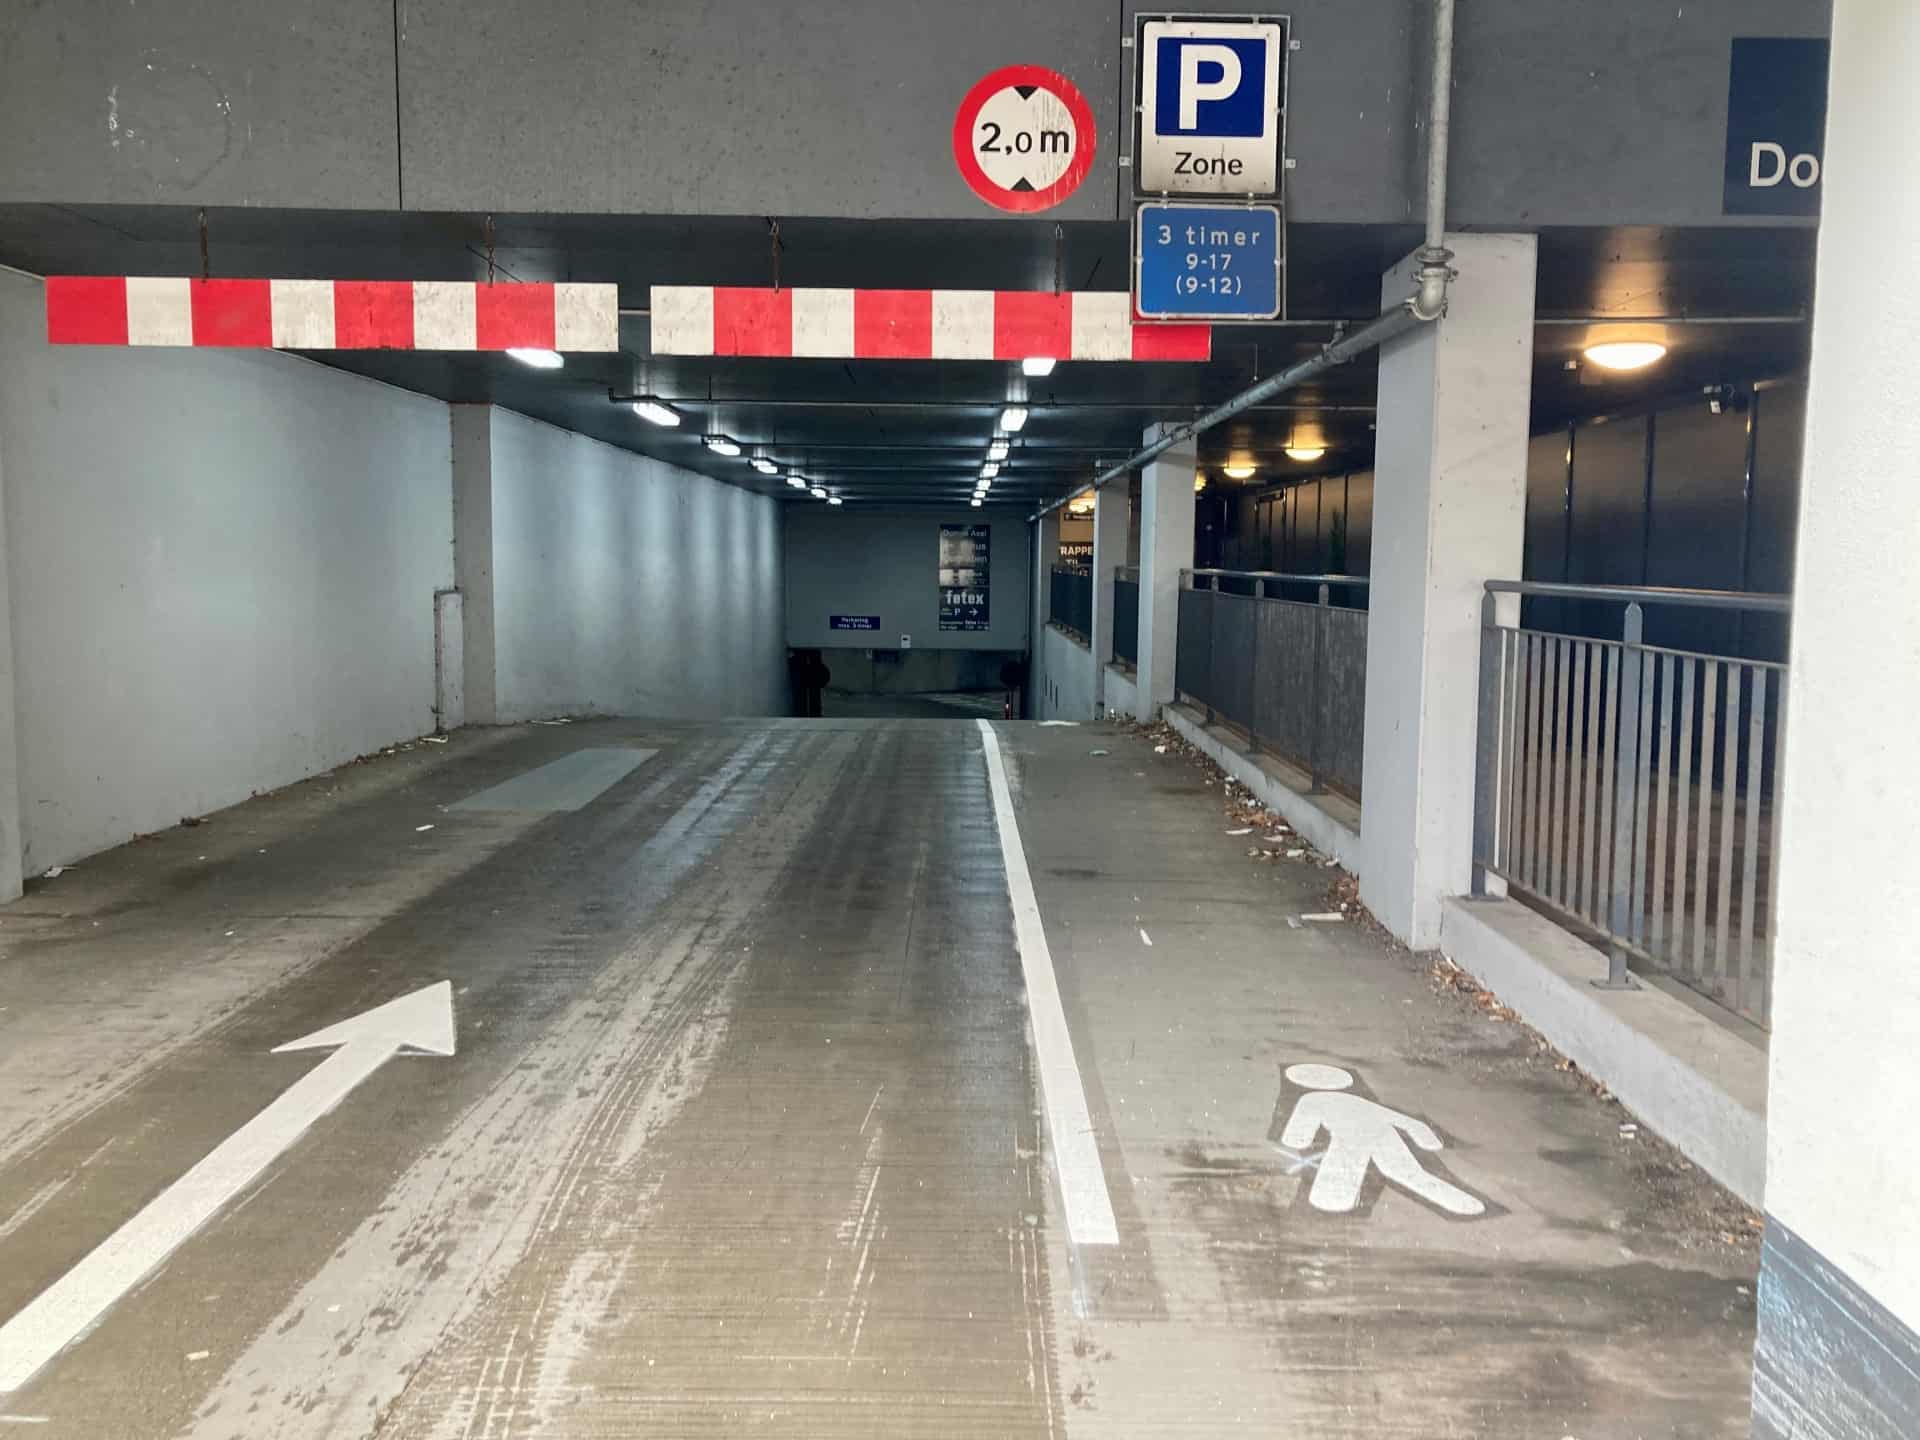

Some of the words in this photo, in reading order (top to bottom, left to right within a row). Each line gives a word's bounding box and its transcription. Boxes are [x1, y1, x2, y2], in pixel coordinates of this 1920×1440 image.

[1178, 43, 1242, 130] P
[1174, 152, 1243, 176] Zone
[1157, 225, 1172, 245] 3
[1185, 226, 1261, 246] timer
[1186, 253, 1232, 270] 9-17
[1175, 275, 1242, 295] (9-12)
